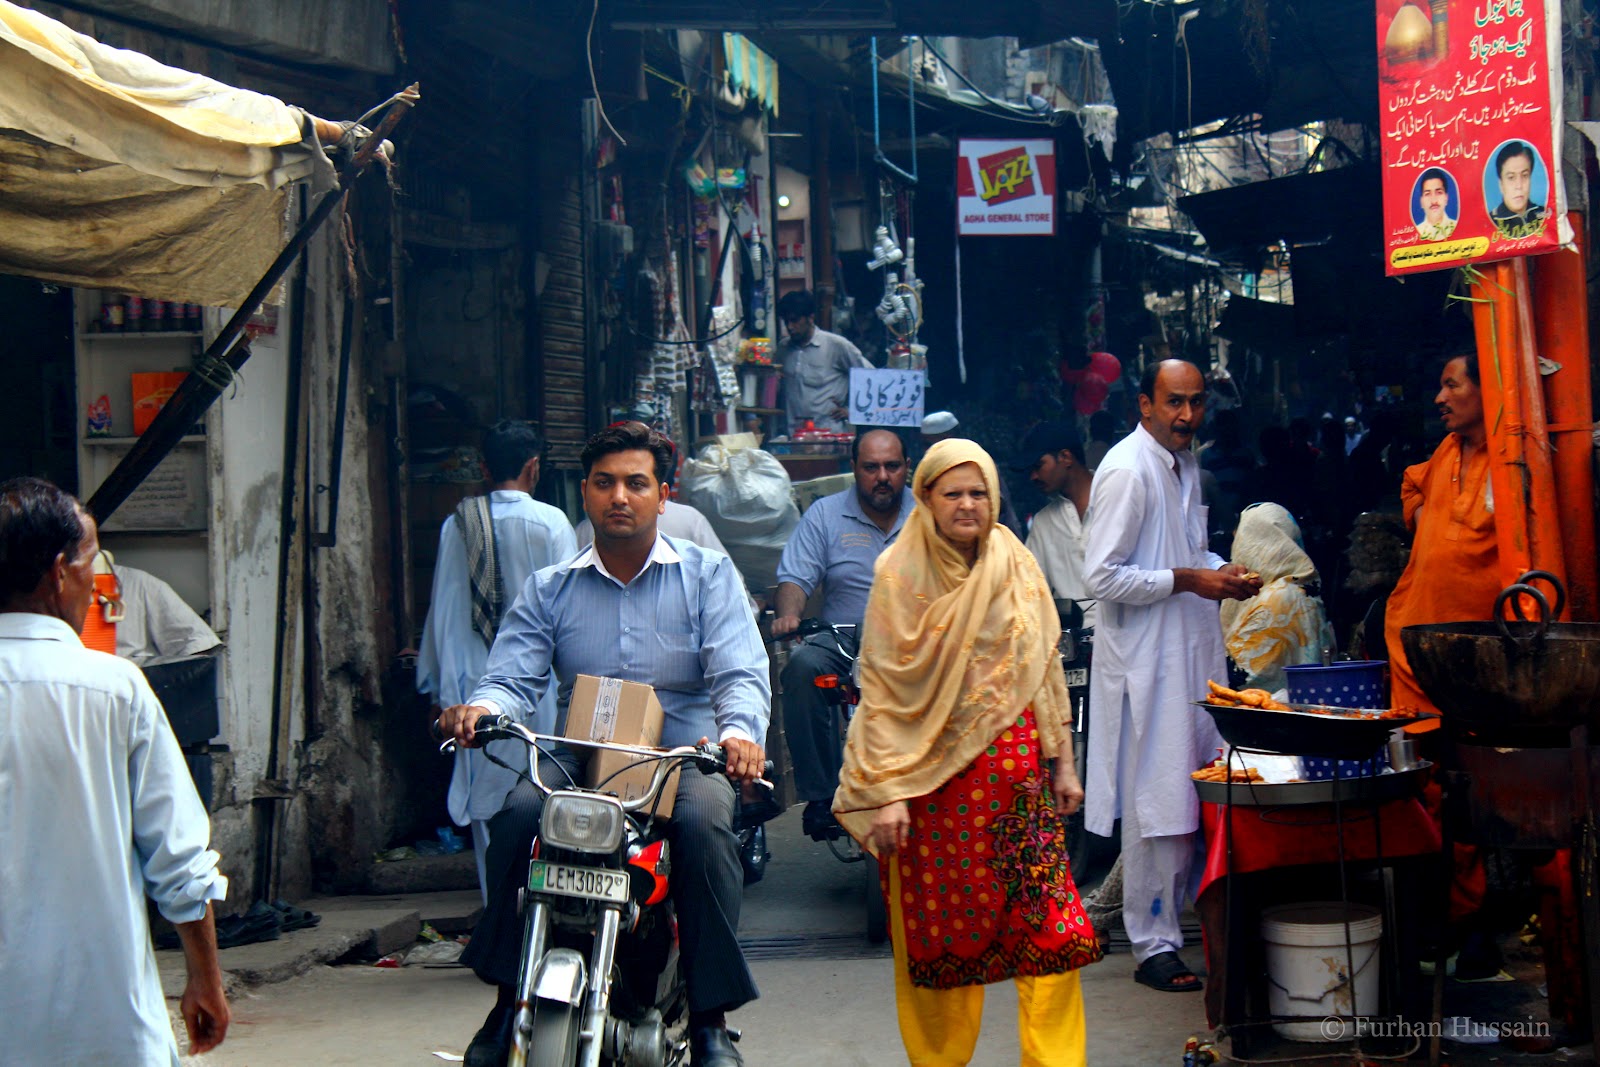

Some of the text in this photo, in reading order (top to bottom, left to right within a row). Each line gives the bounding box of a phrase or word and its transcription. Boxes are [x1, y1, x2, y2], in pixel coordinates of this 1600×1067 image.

[1505, 18, 1533, 58] ایک
[1463, 69, 1484, 95] کھلے
[1480, 70, 1496, 92] کے
[1497, 65, 1513, 95] قوم
[1517, 61, 1537, 85] ملک
[1444, 71, 1464, 102] دشمن
[1455, 108, 1468, 134] ہم
[1497, 97, 1524, 123] ہوشیار
[1522, 102, 1542, 114] سے
[1387, 115, 1406, 141] ایک
[1405, 110, 1436, 138] پاکستانی
[1436, 115, 1457, 132] سب
[1411, 149, 1434, 168] رہیں
[1432, 139, 1451, 165] ایک
[1449, 142, 1463, 159] اور
[1464, 140, 1480, 159] ہیں
[980, 155, 1033, 201] JAZZ
[964, 213, 1050, 223] AGHA GENERAL STORE
[855, 374, 920, 422] فوٹو کاپی
[546, 866, 613, 897] LEM3082
